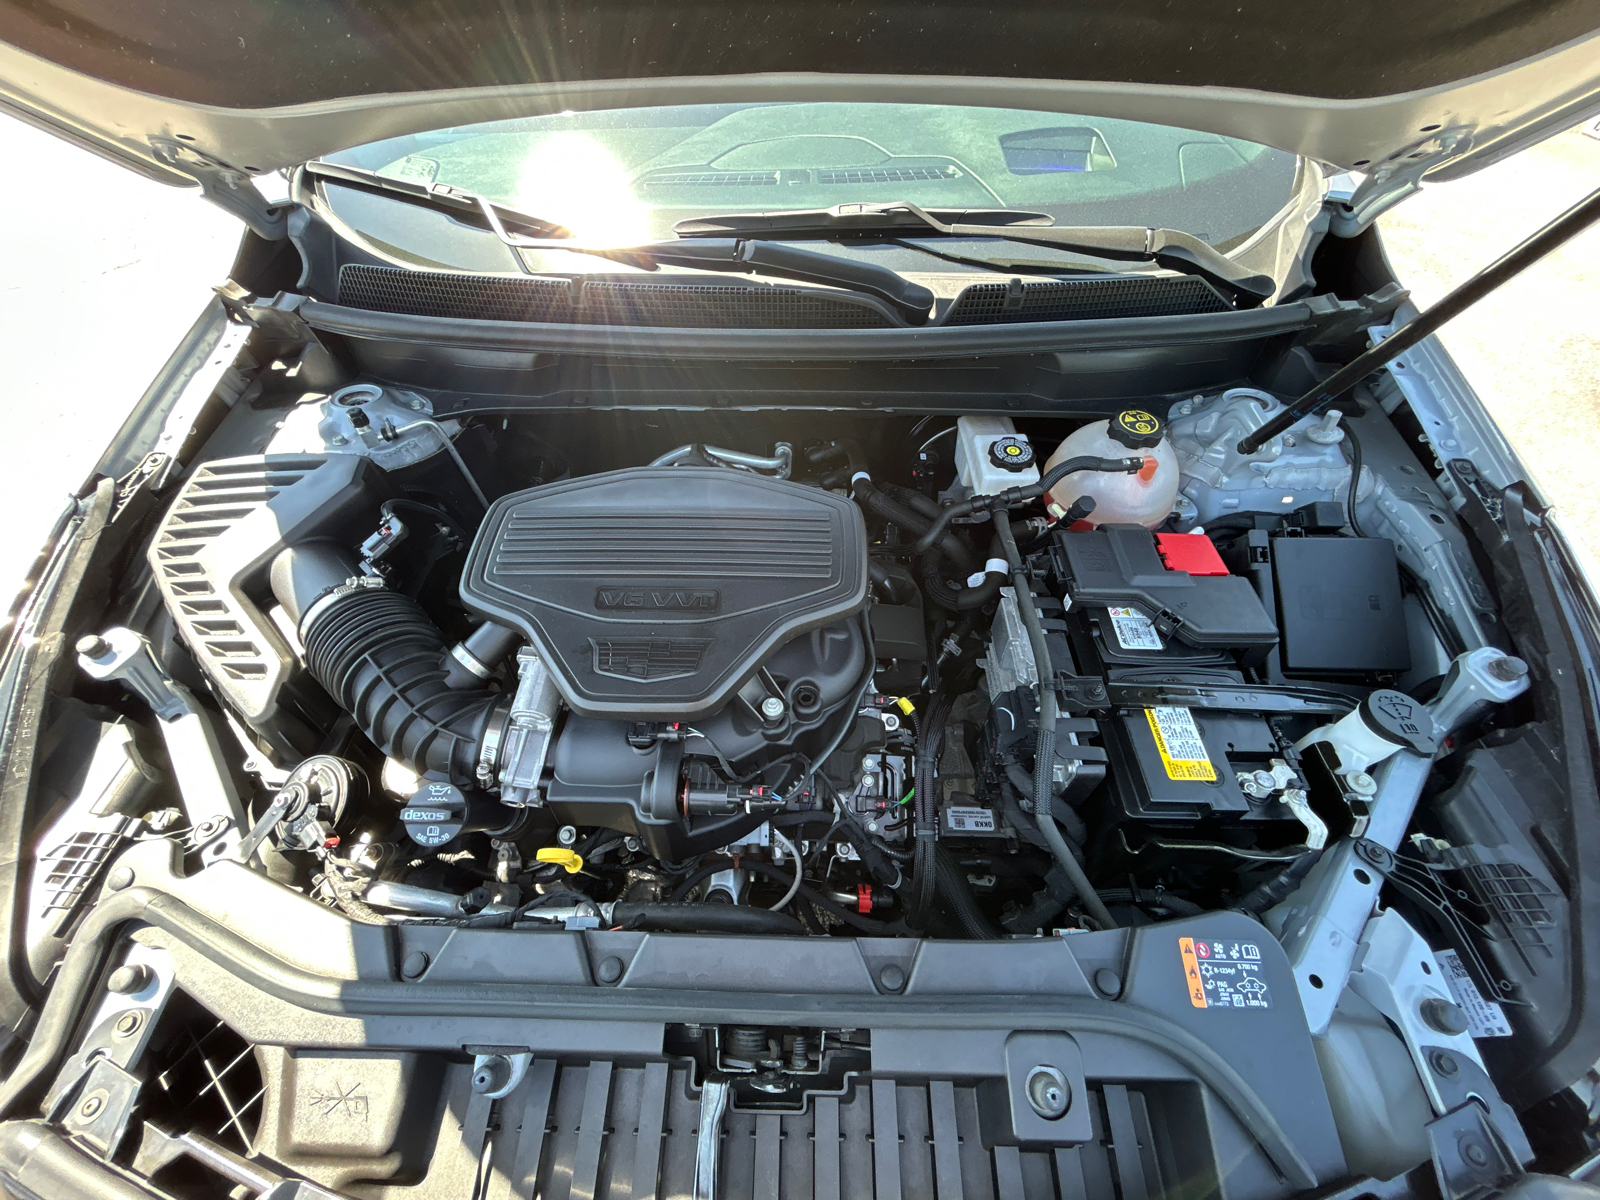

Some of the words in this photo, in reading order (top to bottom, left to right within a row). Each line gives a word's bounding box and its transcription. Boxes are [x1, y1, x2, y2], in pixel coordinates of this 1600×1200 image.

[600, 592, 645, 607] V6
[651, 592, 715, 607] VVT
[404, 809, 446, 820] dexos
[416, 833, 428, 843] SAE
[429, 833, 450, 844] 5W-30
